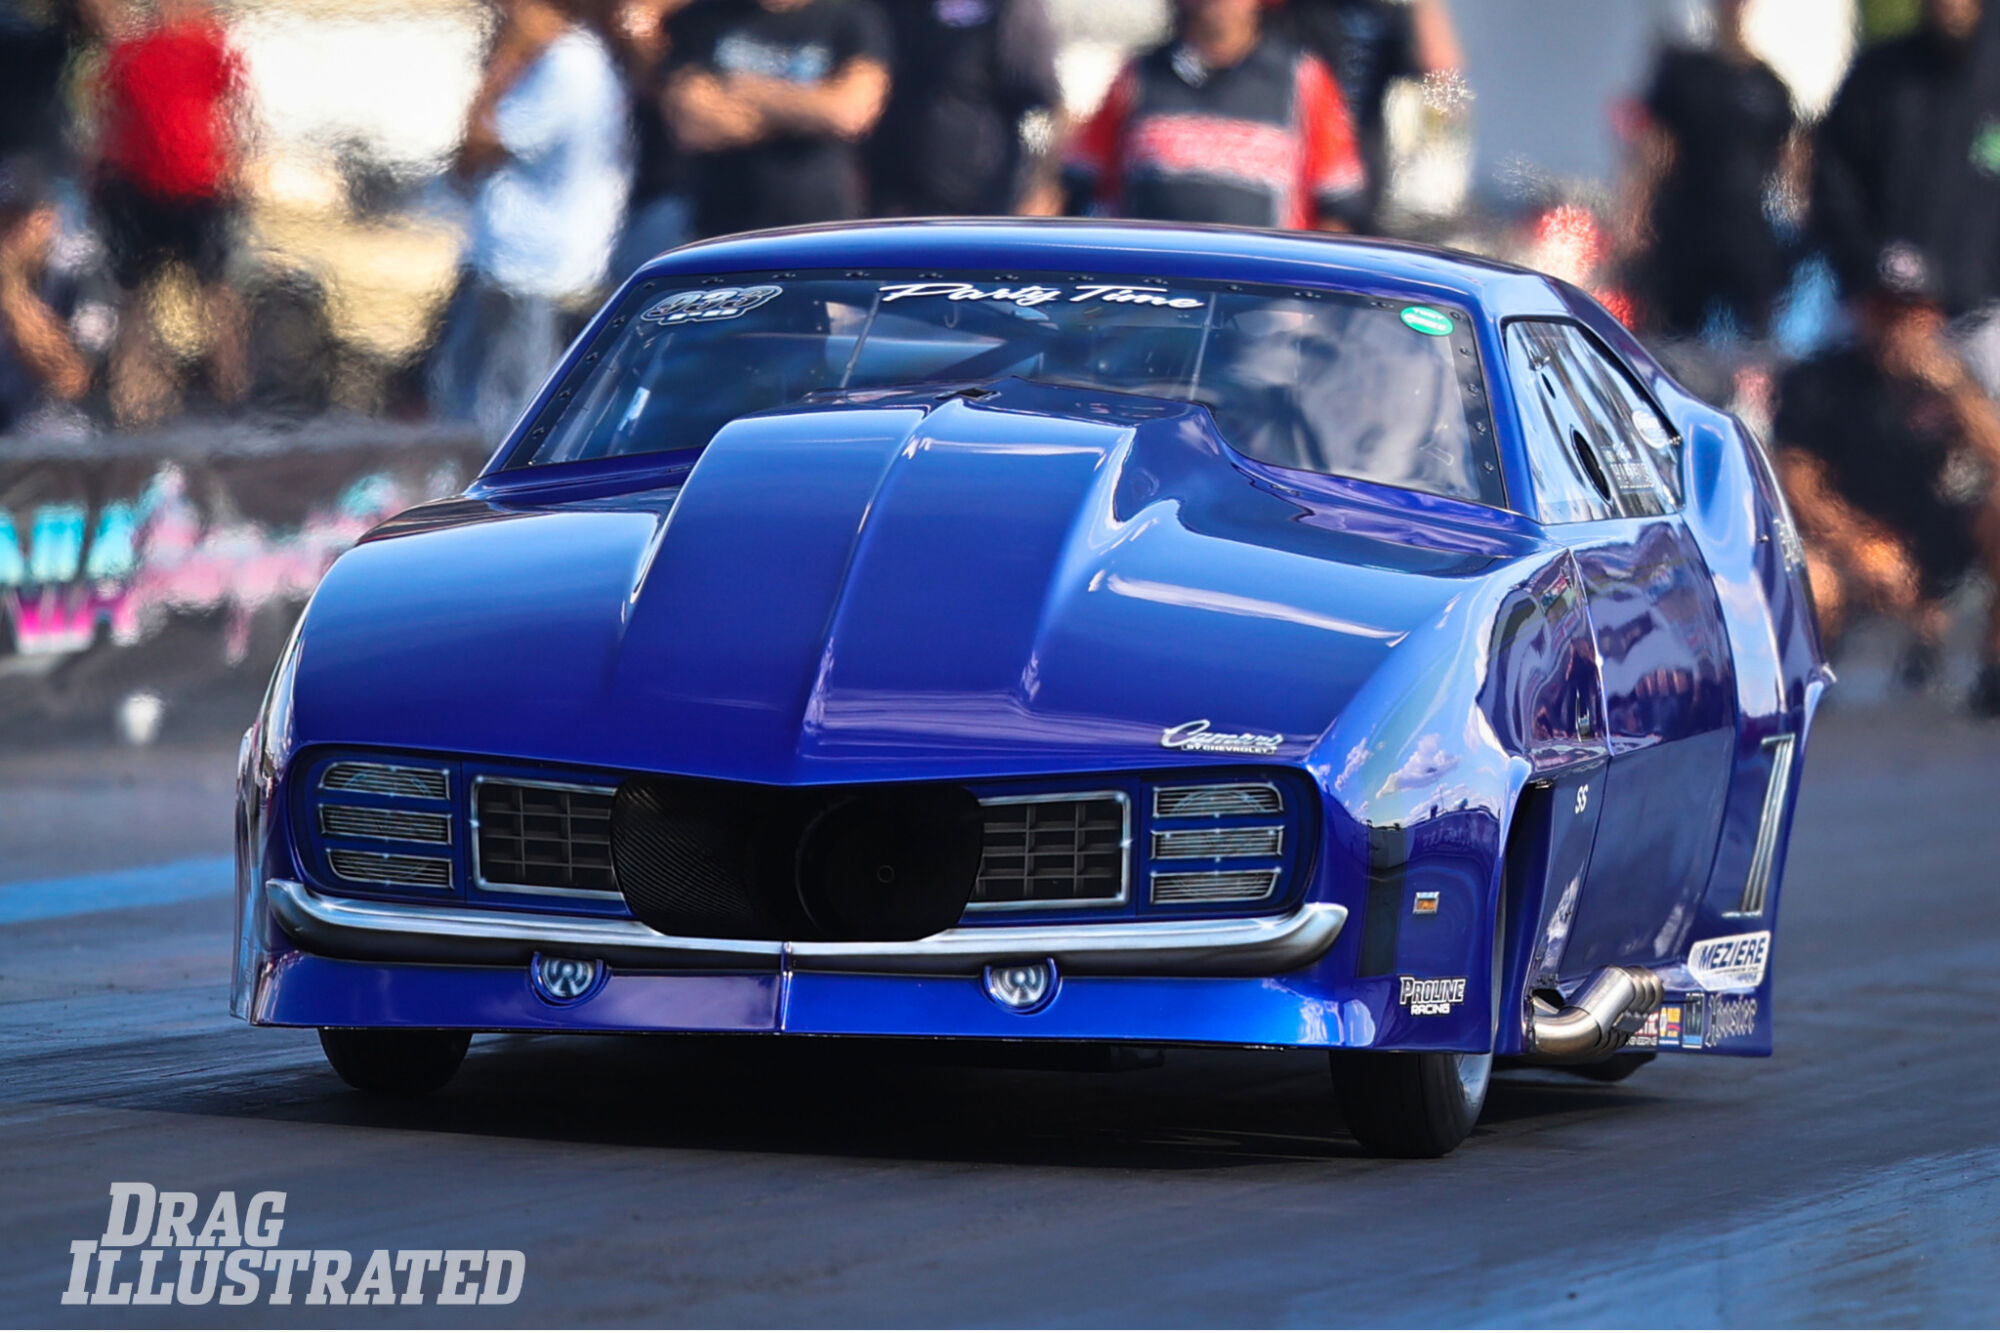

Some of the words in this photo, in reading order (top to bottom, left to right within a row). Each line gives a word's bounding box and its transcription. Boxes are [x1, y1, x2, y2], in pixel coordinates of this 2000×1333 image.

[878, 282, 1062, 306] Party
[1069, 284, 1206, 309] Time
[1161, 719, 1284, 747] Camaro
[1202, 744, 1269, 754] CHEVROLET
[1574, 783, 1589, 815] SS
[1698, 937, 1767, 971] MEZIERE
[1399, 976, 1467, 1005] PROLINE
[1410, 1003, 1451, 1016] RACING
